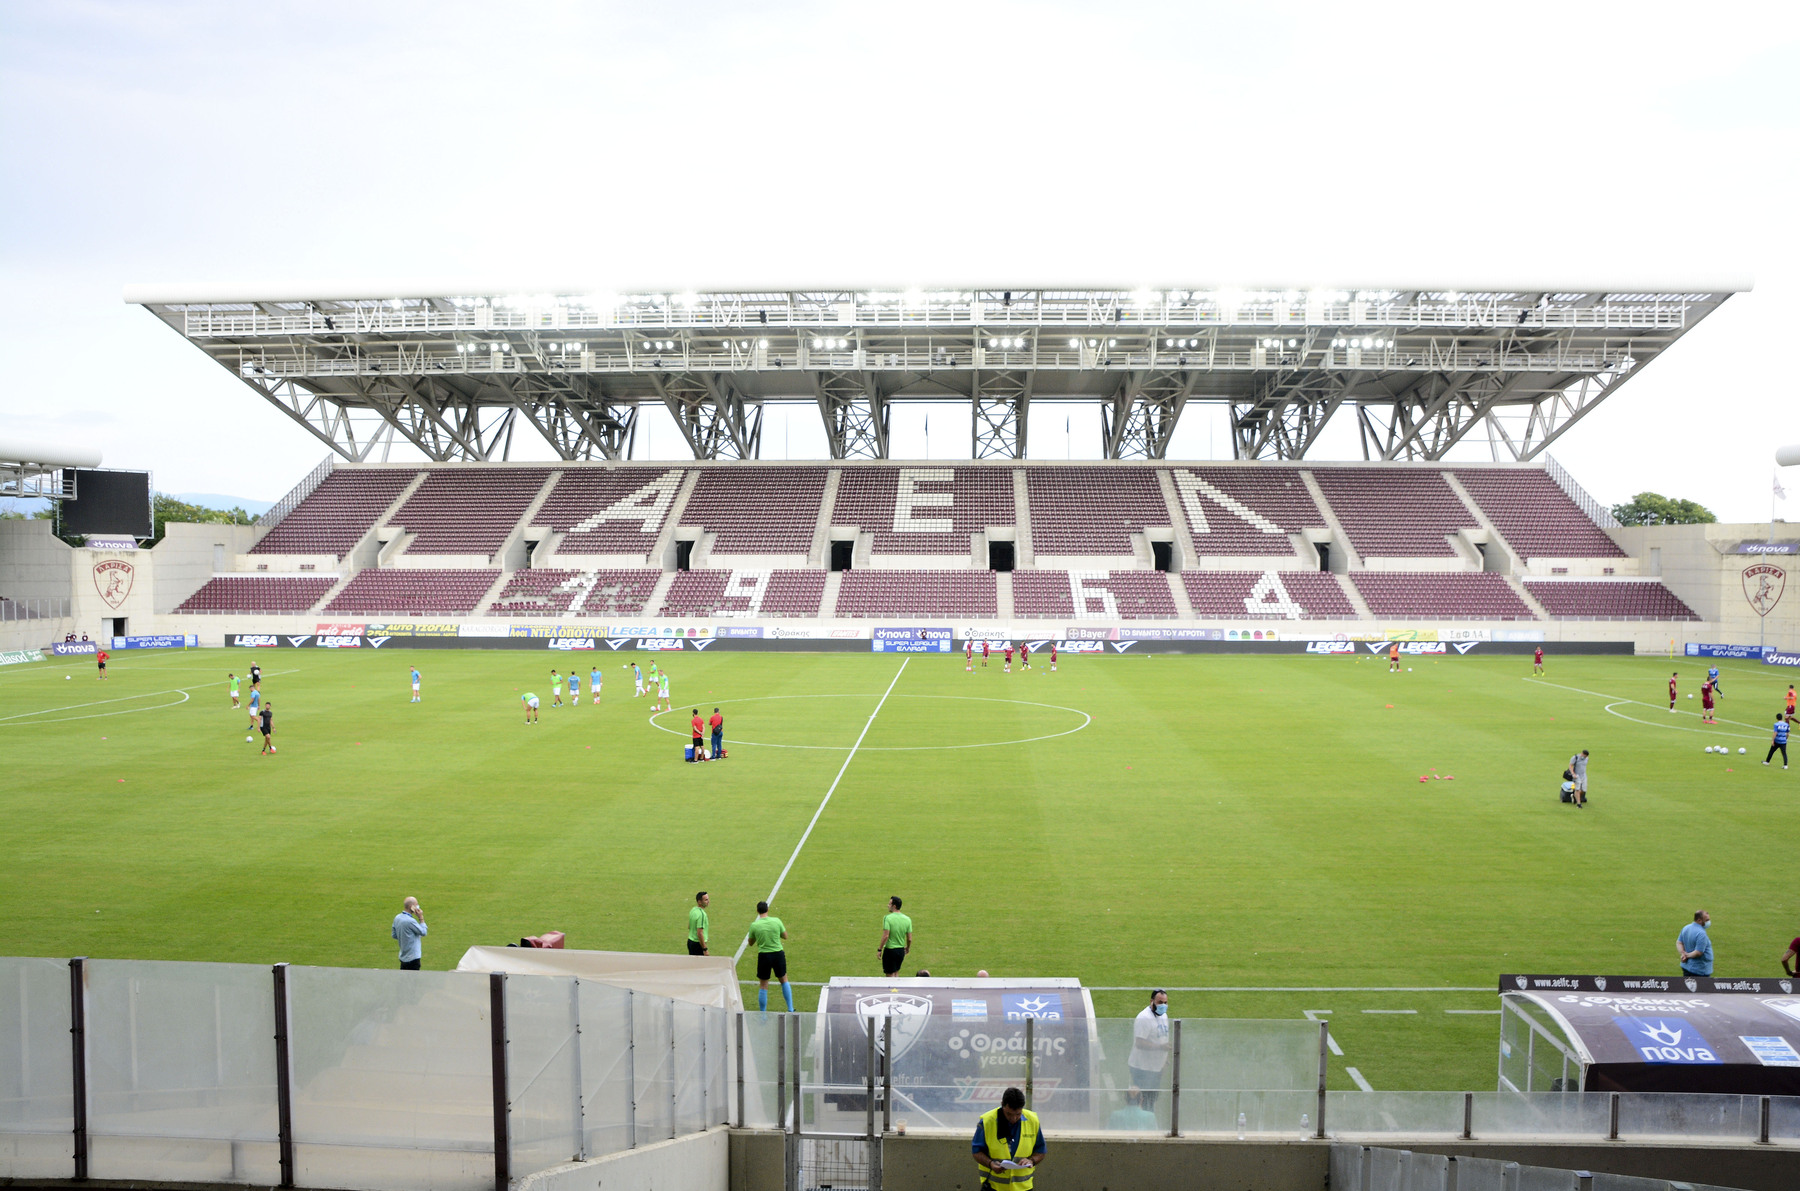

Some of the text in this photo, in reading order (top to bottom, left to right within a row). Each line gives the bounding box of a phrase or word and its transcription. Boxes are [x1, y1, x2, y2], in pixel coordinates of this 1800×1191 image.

[98, 562, 130, 573] ΛΑΡΙΣΑ
[611, 627, 657, 636] LEGEA
[887, 631, 911, 639] nova
[926, 631, 950, 639] nova
[1080, 629, 1106, 639] Bayer
[234, 635, 278, 645] LEGEA
[316, 636, 361, 646] LEGEA
[548, 638, 595, 648] LEGEA
[636, 639, 684, 649] LEGEA
[1055, 640, 1104, 650] LEGEA
[68, 644, 95, 653] nova
[1306, 642, 1355, 652] LEGEA
[1398, 642, 1446, 652] LEGEA
[1777, 656, 1800, 665] nov
[1534, 978, 1579, 990] www.aelfc.gr
[1623, 979, 1669, 991] www.aelfc.gr
[1714, 981, 1761, 993] www.aelfc.gr
[1007, 1011, 1060, 1021] nova
[1640, 1046, 1716, 1061] nova
[980, 1052, 1041, 1069] γεύσες
